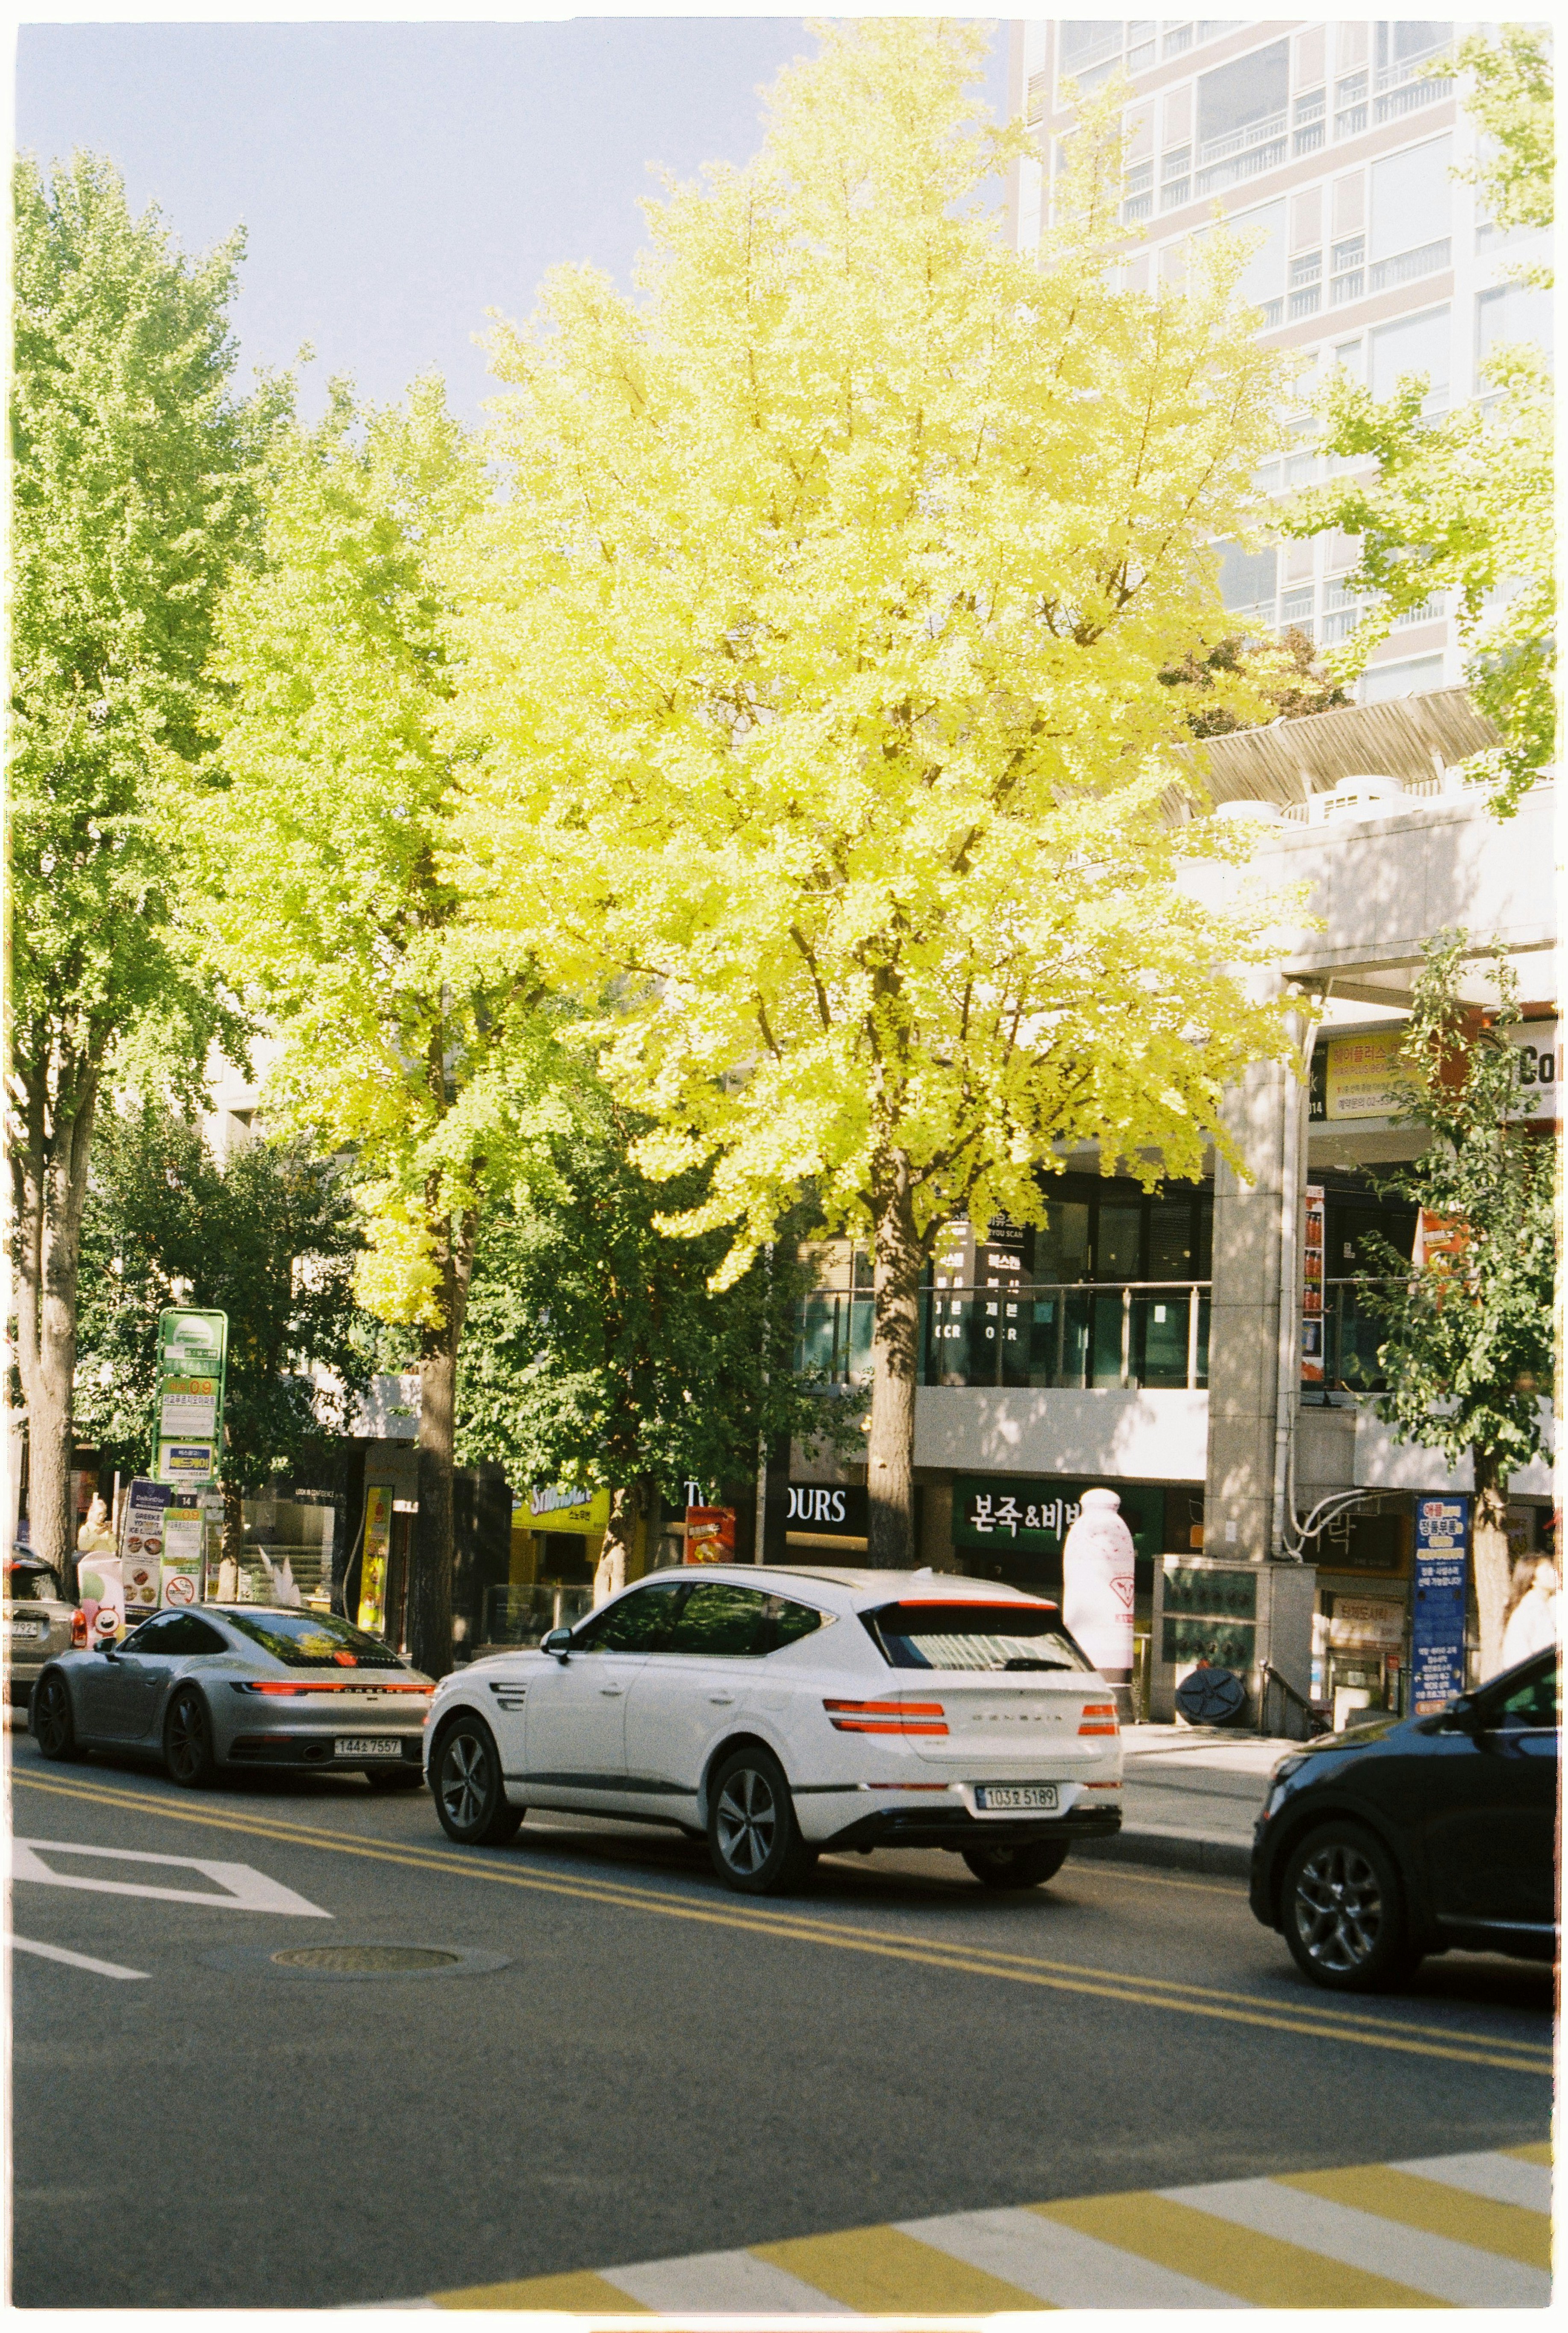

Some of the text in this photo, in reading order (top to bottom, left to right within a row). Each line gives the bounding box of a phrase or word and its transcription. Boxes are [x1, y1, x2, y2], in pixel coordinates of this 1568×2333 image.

[1333, 1046, 1387, 1064] 헤어플러스
[190, 1380, 212, 1394] 09
[182, 1497, 191, 1505] 14
[182, 1510, 200, 1520] 09
[371, 1740, 397, 1752] 7557
[1024, 1789, 1053, 1806] 5189
